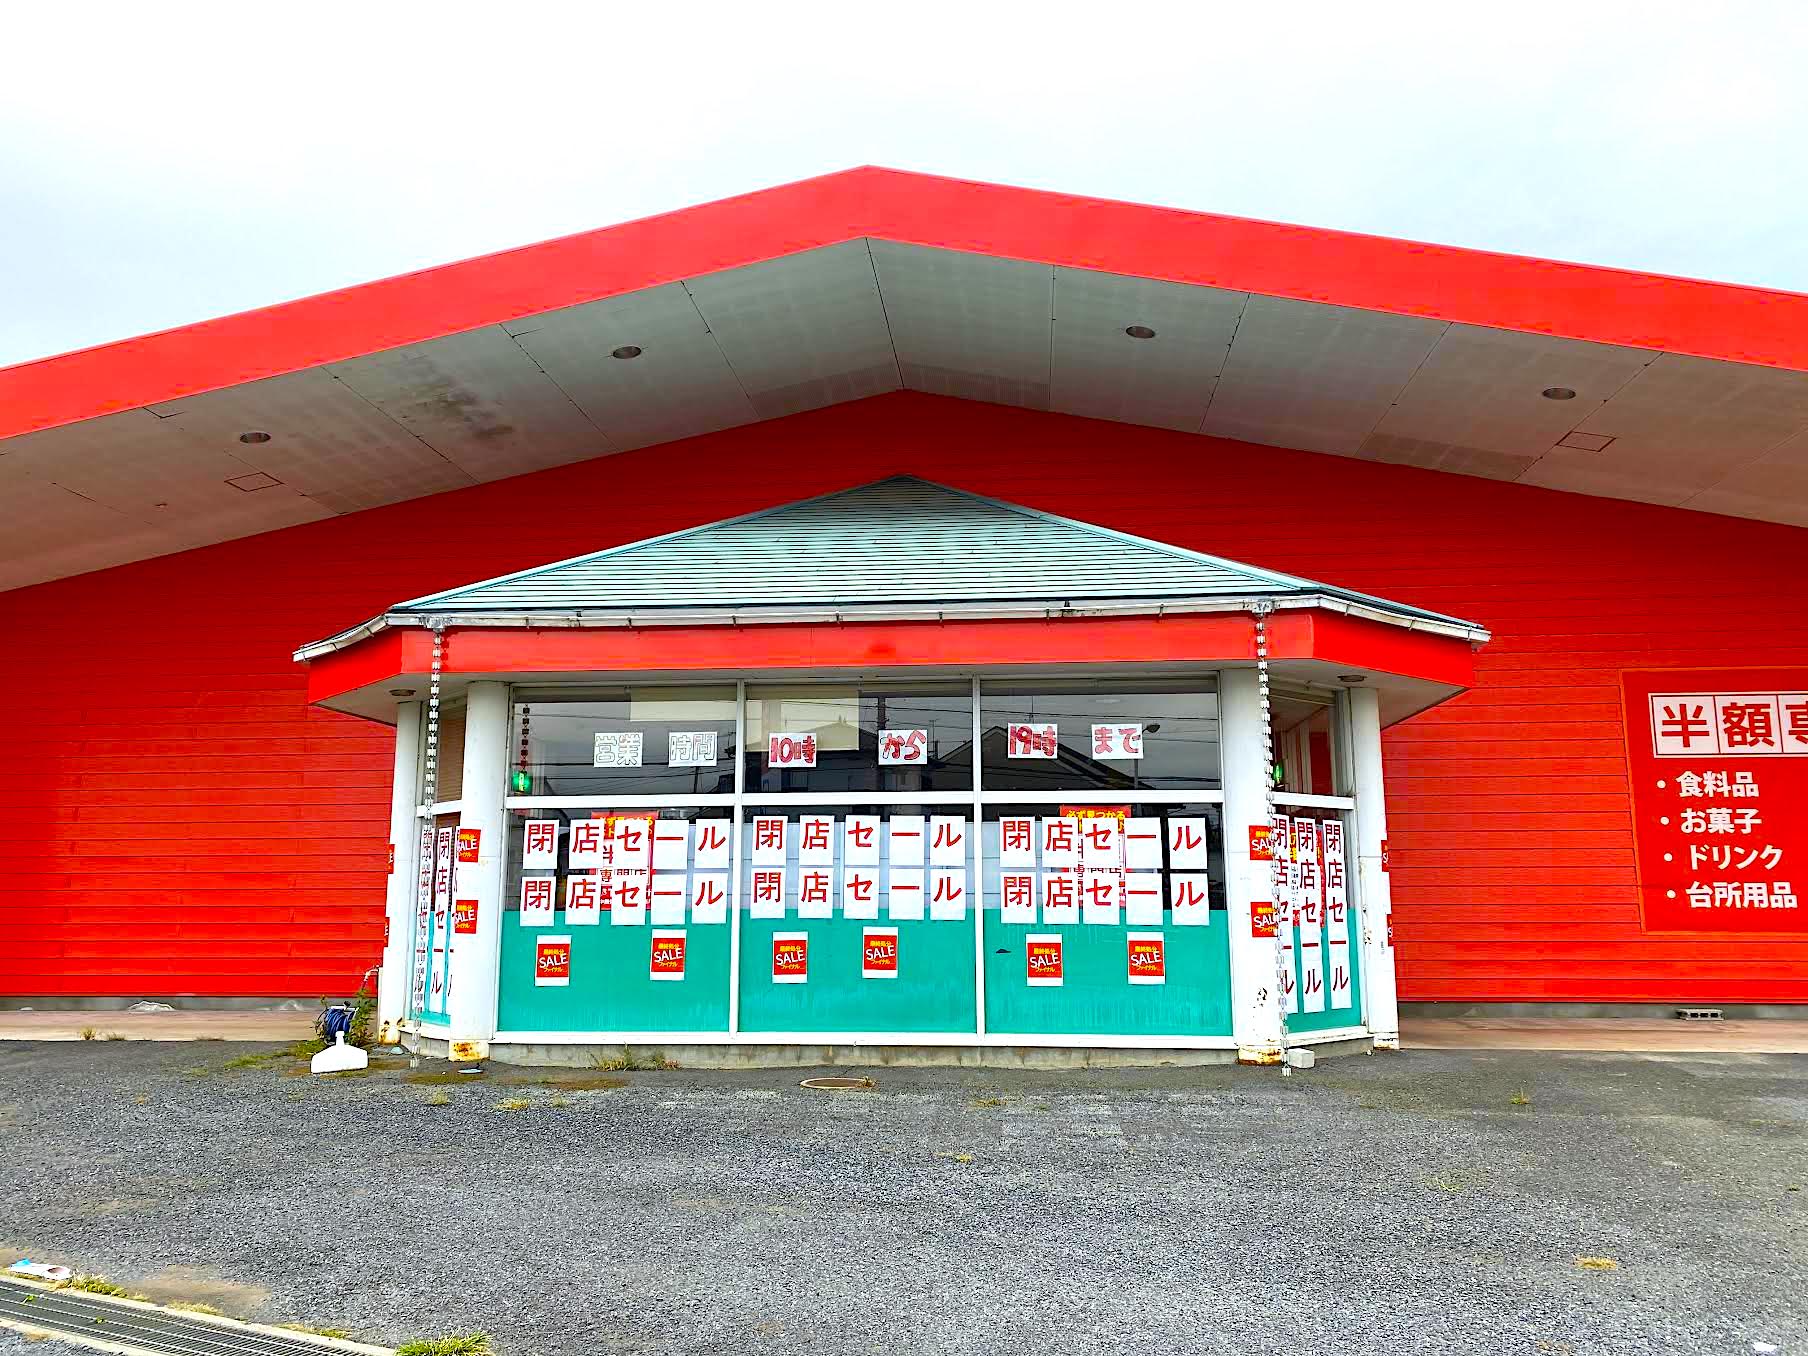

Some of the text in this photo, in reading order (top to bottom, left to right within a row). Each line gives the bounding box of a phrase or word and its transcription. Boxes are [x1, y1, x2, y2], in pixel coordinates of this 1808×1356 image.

[595, 725, 1140, 765] 営業 時間 10時 から 19時 まで
[1675, 770, 1760, 798] 食料品
[756, 819, 963, 850] 閉店セール
[1680, 807, 1762, 834] お菓子
[527, 824, 727, 855] 閉店セール
[1002, 820, 1203, 852] 閉店セール
[1690, 844, 1783, 870] ドリンク
[523, 880, 724, 912] 閉店セール
[753, 872, 963, 903] 閉店セール
[1003, 877, 1205, 908] 閉店セール
[1685, 881, 1798, 909] 台所用品
[431, 831, 450, 994] 閉店セール
[1297, 821, 1322, 995] 閉店セール
[1325, 823, 1349, 992] 閉店セール
[538, 952, 569, 969] SALE
[653, 947, 684, 963] SALE
[775, 949, 806, 966] SALE
[865, 945, 896, 961] SALE
[1029, 952, 1060, 969] SALE
[1130, 950, 1162, 967] SALE
